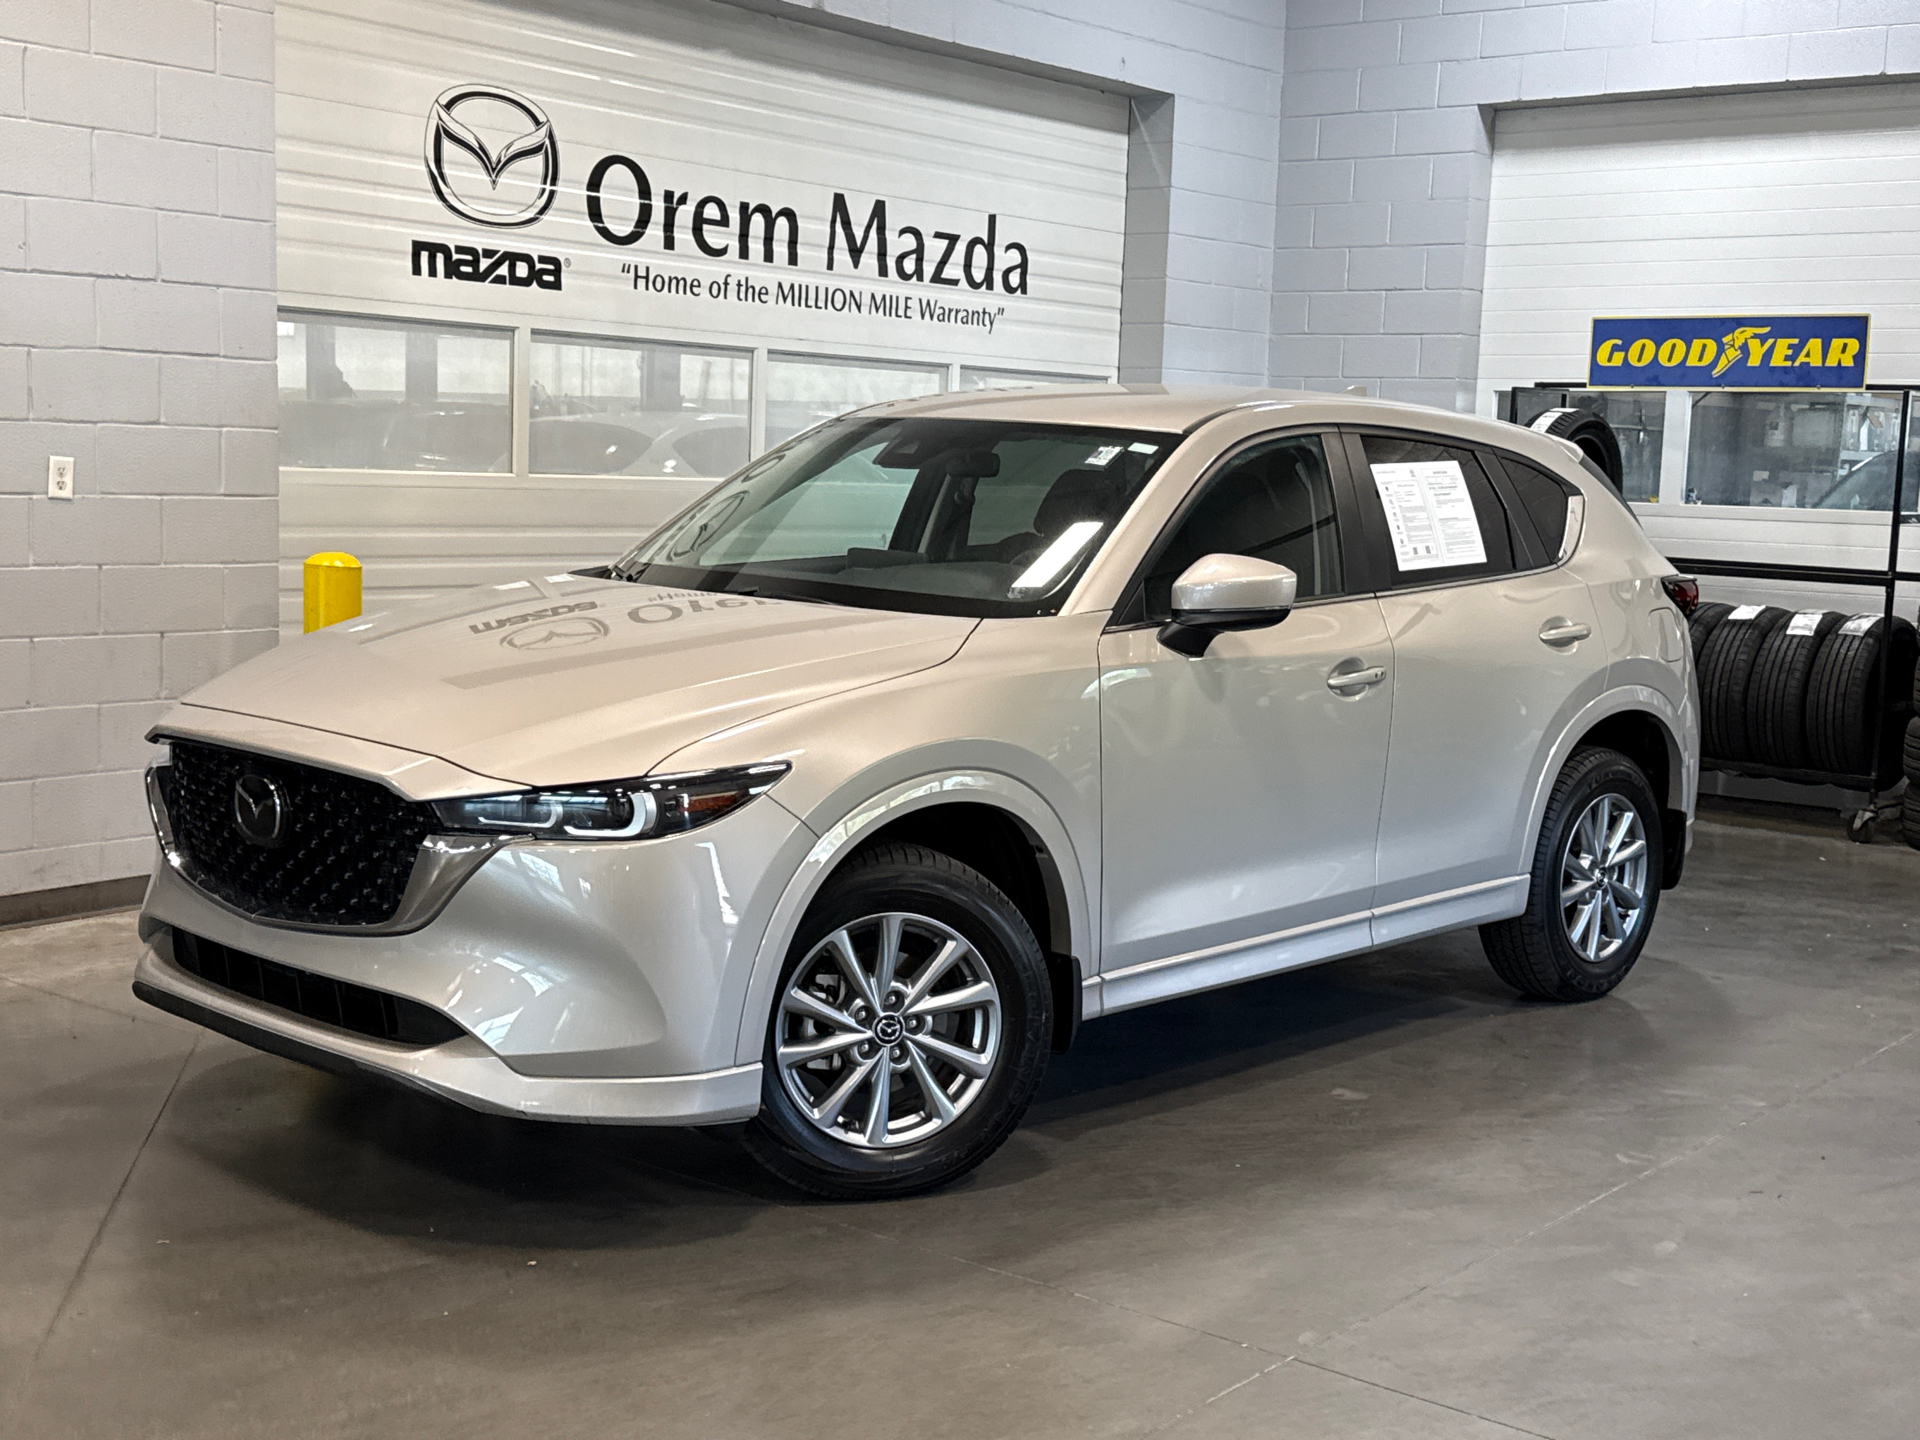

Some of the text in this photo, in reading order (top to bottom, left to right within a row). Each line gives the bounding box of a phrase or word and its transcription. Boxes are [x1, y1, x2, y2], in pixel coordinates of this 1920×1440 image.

[586, 154, 1030, 296] Orem Mazda
[411, 239, 562, 291] mazda
[708, 274, 732, 300] of
[736, 276, 769, 304] the
[775, 281, 862, 314] MILLION
[868, 291, 912, 319] MILE
